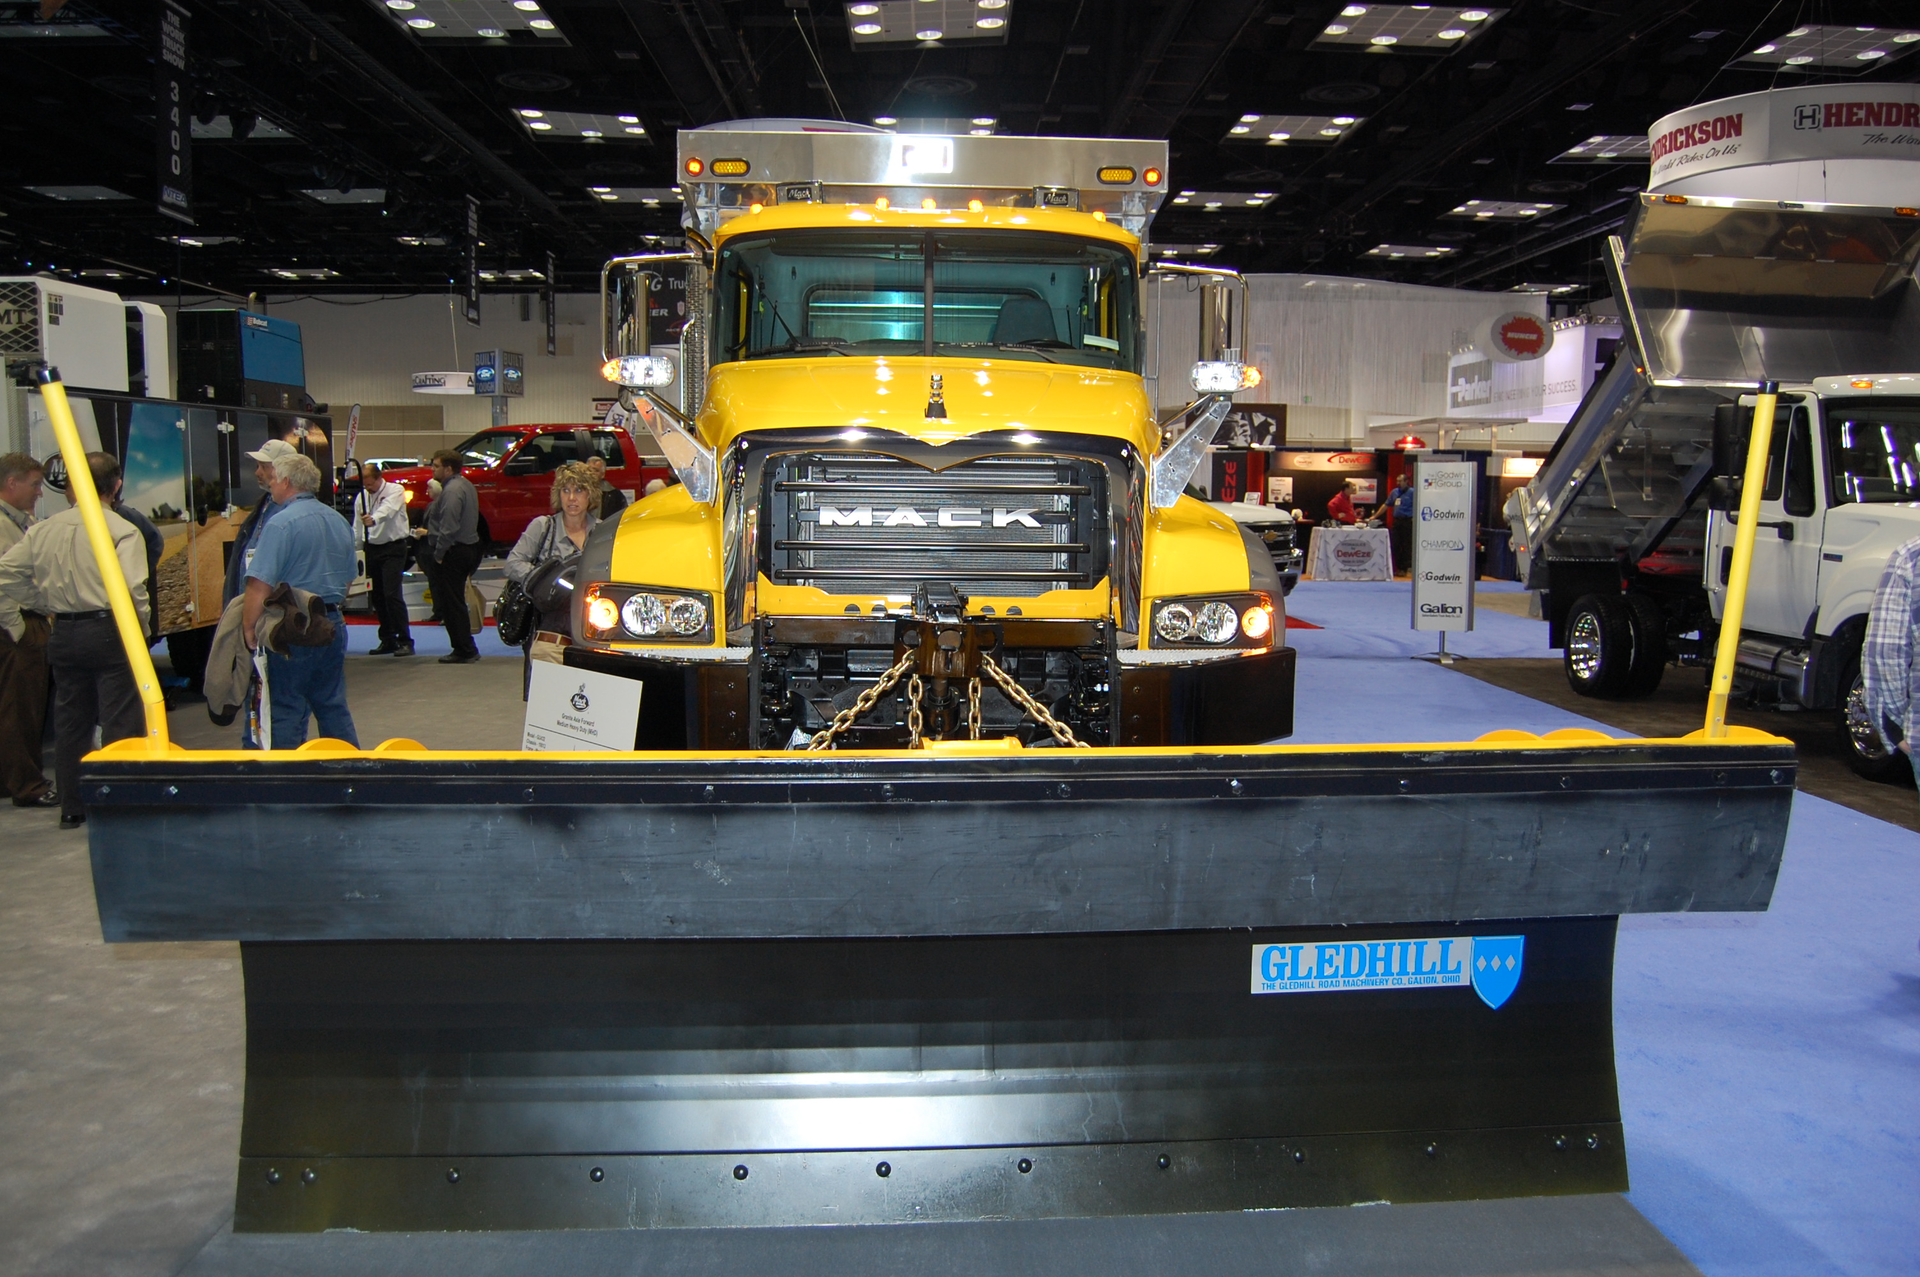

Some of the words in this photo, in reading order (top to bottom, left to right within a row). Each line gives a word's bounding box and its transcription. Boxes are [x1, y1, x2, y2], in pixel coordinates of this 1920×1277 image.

[166, 10, 180, 28] THE
[162, 20, 185, 44] WORK
[162, 34, 185, 58] TRUCK
[162, 49, 185, 70] SHOW
[170, 81, 180, 175] 3400
[1862, 133, 1888, 145] The
[1676, 152, 1704, 166] Rides
[1705, 147, 1722, 159] On
[1721, 144, 1738, 156] Us
[163, 187, 187, 204] NTEA
[788, 189, 812, 199] Mack
[1044, 191, 1068, 204] Mack
[1507, 332, 1538, 340] MUNCIE
[476, 353, 495, 366] BUILT
[503, 353, 523, 366] BUILT
[476, 381, 496, 393] TOUGH
[503, 381, 523, 393] TOUGH
[1457, 375, 1491, 402] Parker
[1437, 471, 1466, 479] Godwin
[1437, 480, 1462, 488] Group
[819, 506, 1044, 528] MACK
[1433, 509, 1465, 519] Godwin
[1421, 540, 1460, 549] CHAMPION
[1425, 571, 1461, 582] Godwin
[1420, 603, 1463, 614] Galion
[1261, 940, 1462, 982] GLEDHILL
[1261, 982, 1276, 991] THE
[1279, 980, 1315, 990] GLEDHILL
[1318, 979, 1341, 989] ROAD
[1343, 977, 1390, 987] MACHINERY
[1441, 974, 1461, 984] OHIO
